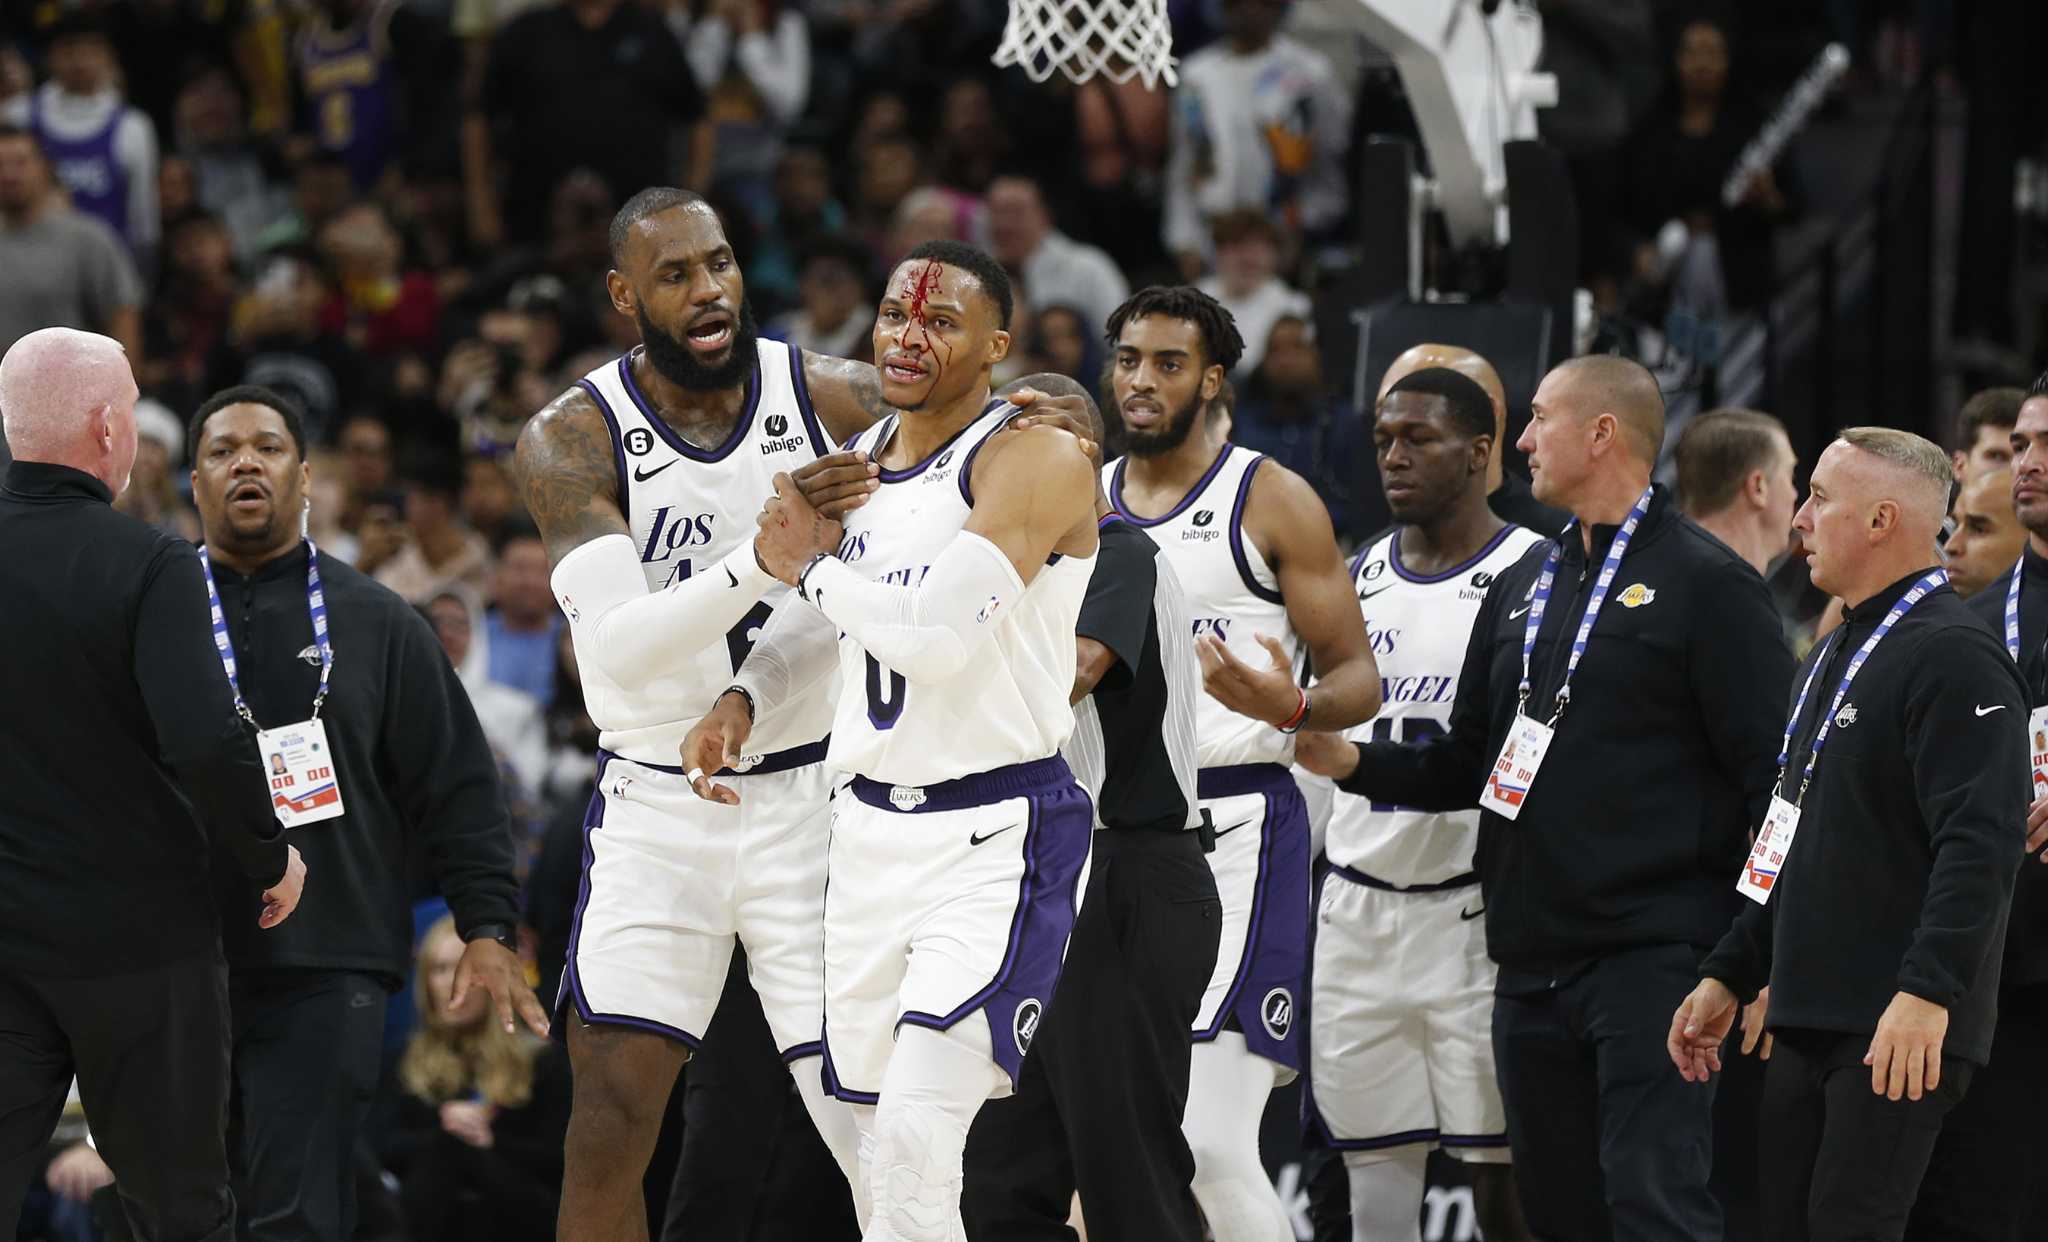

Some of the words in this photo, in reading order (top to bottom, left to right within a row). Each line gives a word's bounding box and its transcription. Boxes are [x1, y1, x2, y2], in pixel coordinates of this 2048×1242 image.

[629, 431, 648, 453] 6
[760, 436, 805, 456] bibigo
[922, 469, 952, 485] bibigo
[1181, 529, 1220, 543] bibigo
